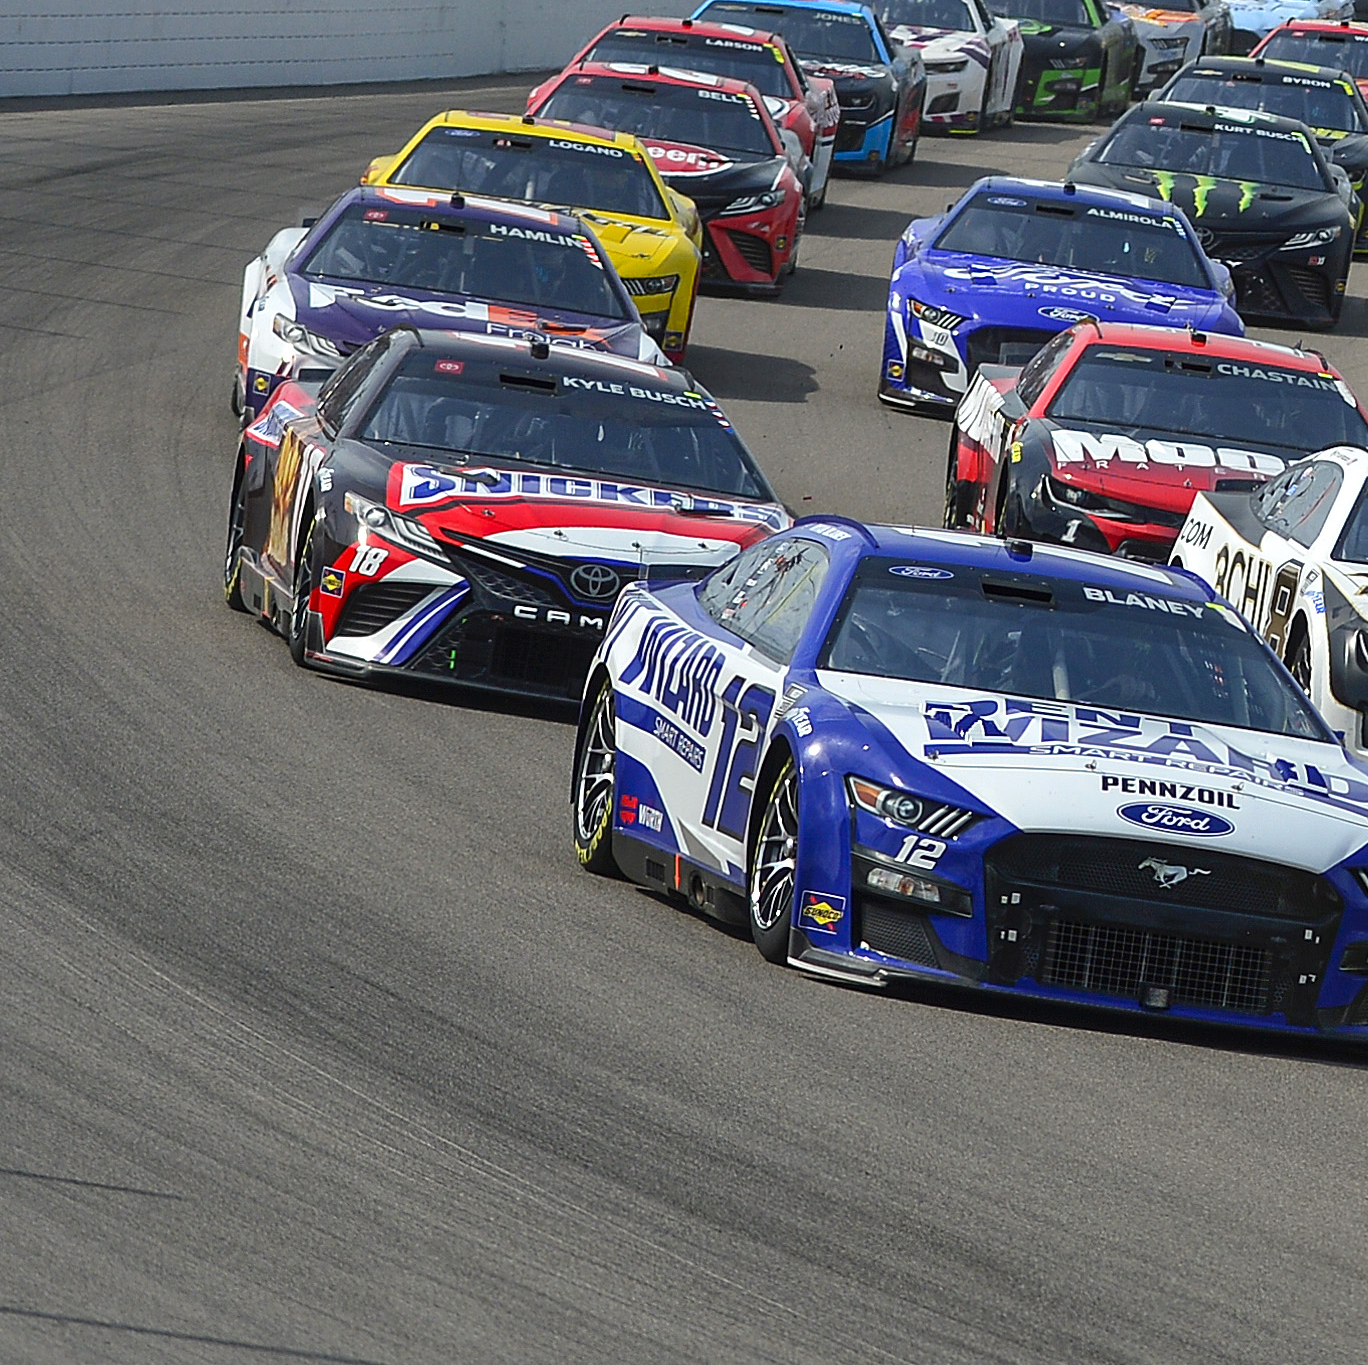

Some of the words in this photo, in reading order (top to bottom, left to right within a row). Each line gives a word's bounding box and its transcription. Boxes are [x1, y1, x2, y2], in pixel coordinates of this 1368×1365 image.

[813, 11, 862, 26] JONES
[705, 38, 763, 53] LARSON
[1282, 76, 1331, 88] BYRON
[698, 90, 743, 105] BELL
[1214, 123, 1254, 135] KURT
[1256, 130, 1303, 142] BUSCH
[549, 139, 623, 159] LOGANO
[646, 145, 719, 170] eem
[1086, 207, 1173, 230] ALMIROLA
[490, 224, 584, 249] HAMLIN
[1025, 282, 1116, 303] PROUD
[1217, 363, 1337, 392] CHASTAIN
[563, 376, 625, 397] KYLE
[629, 387, 707, 411] BUSCH
[1061, 519, 1083, 543] 1
[349, 545, 390, 577] 18
[1083, 587, 1204, 619] BLANEY
[514, 605, 603, 631] CAM
[653, 716, 679, 749] SMART
[701, 674, 777, 845] 12
[1029, 745, 1152, 763] SMART
[1101, 775, 1240, 810] PENNZOIL
[893, 833, 948, 871] 12
